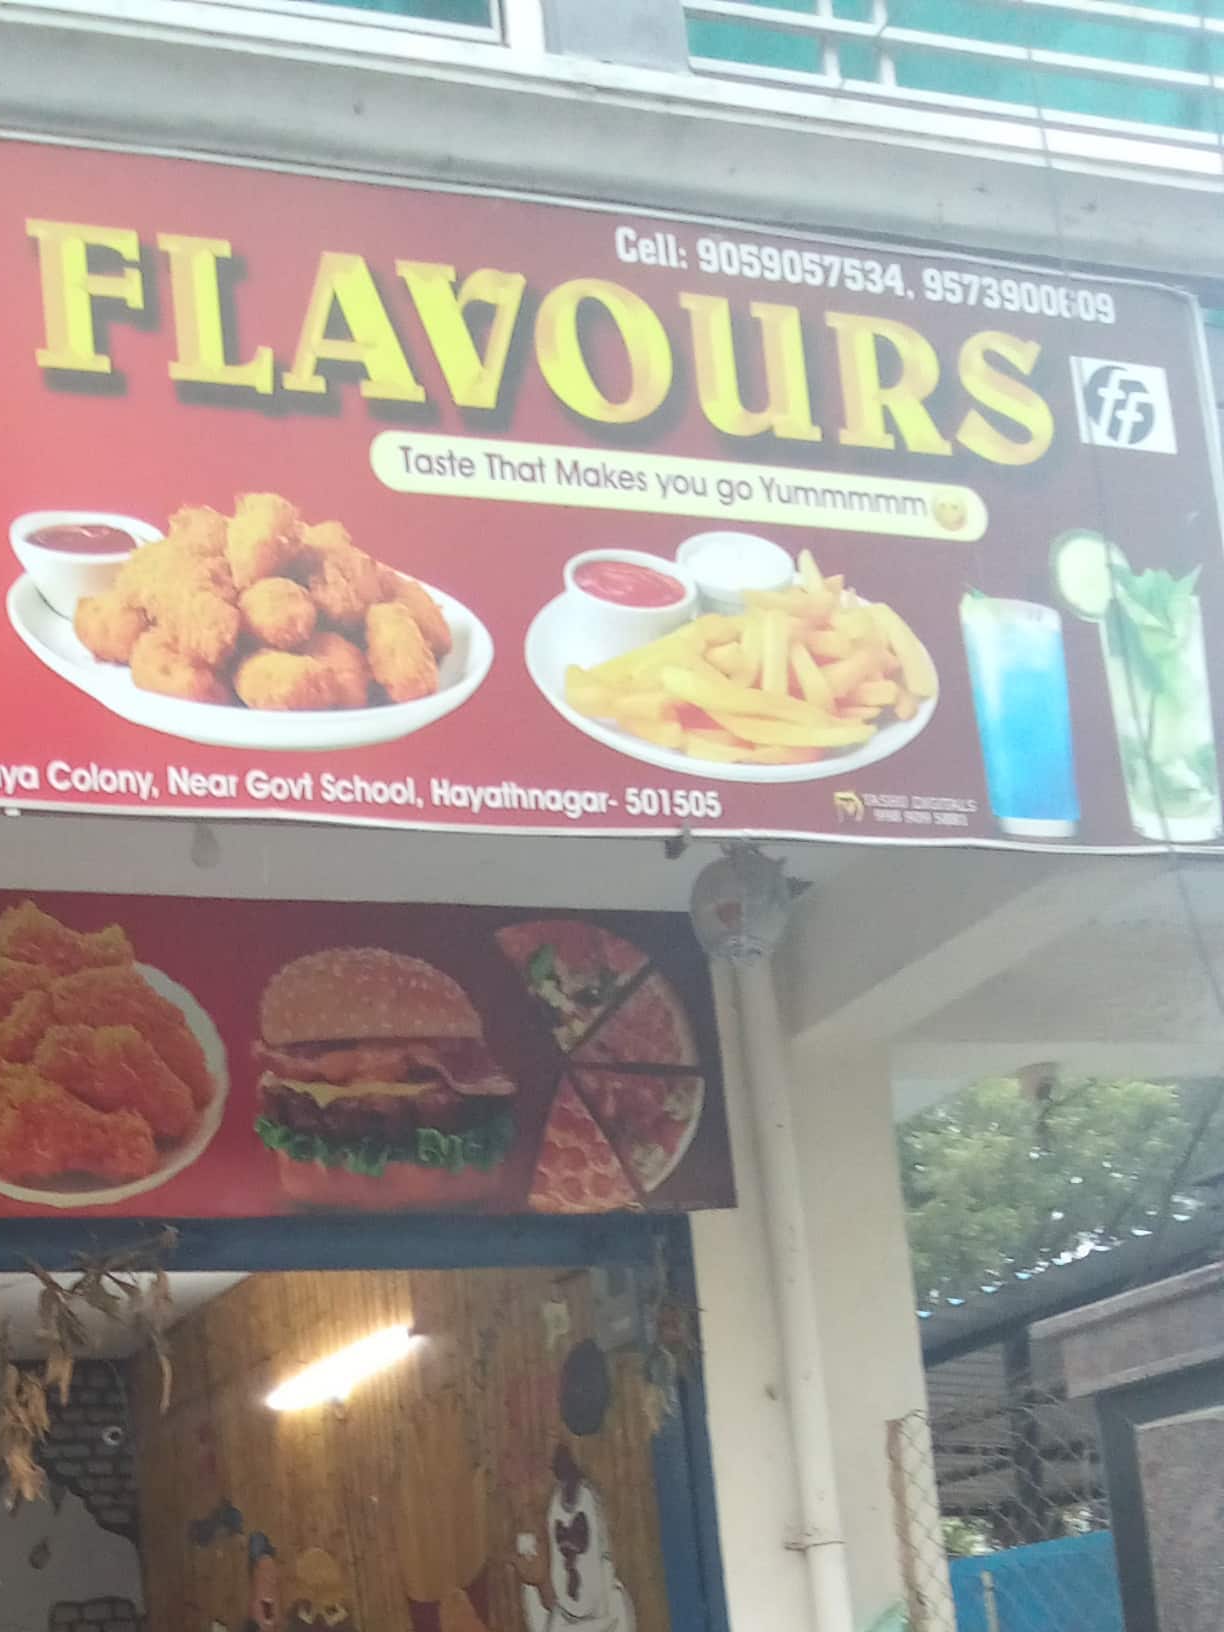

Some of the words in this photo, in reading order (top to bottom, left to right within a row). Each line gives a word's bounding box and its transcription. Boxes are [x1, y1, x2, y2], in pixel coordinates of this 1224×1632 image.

[614, 226, 688, 269] Cell:
[25, 216, 1057, 468] FLAVOURS
[398, 446, 476, 478] Taste
[484, 453, 546, 484] That
[555, 459, 648, 493] Makes
[656, 473, 708, 499] you
[717, 478, 754, 505] go
[46, 761, 159, 800] Colony,
[167, 767, 238, 797] Near
[246, 771, 314, 801] Govt
[321, 775, 424, 808] School,
[431, 780, 617, 818] Hayathnagar-
[625, 788, 722, 818] 501505
